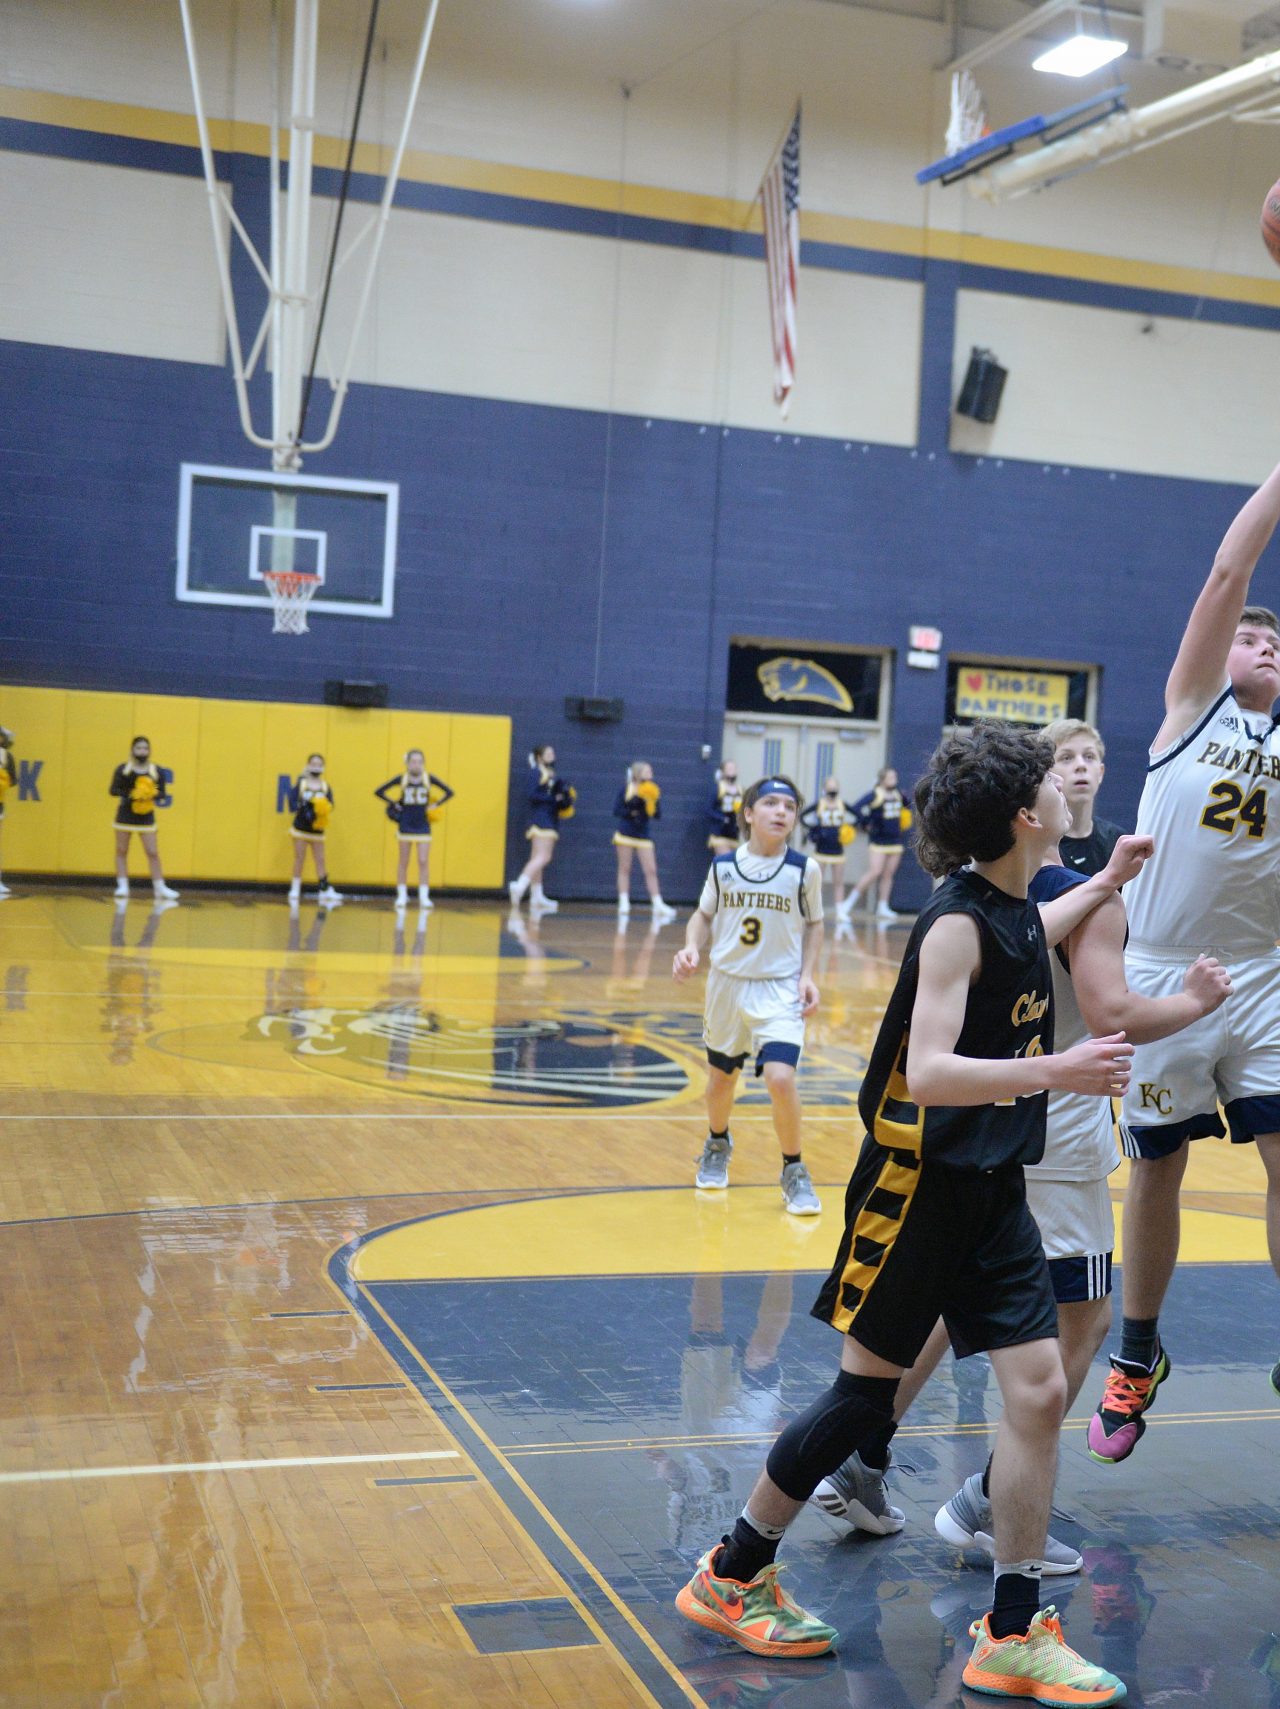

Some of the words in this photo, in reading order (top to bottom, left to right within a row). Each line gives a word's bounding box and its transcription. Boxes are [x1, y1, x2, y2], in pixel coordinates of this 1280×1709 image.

[987, 672, 1049, 696] THOSE
[960, 697, 1060, 719] PANTHERS
[403, 786, 428, 805] KC
[1200, 779, 1268, 841] 24
[722, 892, 791, 913] PANTHERS
[740, 916, 763, 946] 3
[1138, 1082, 1173, 1115] KC
